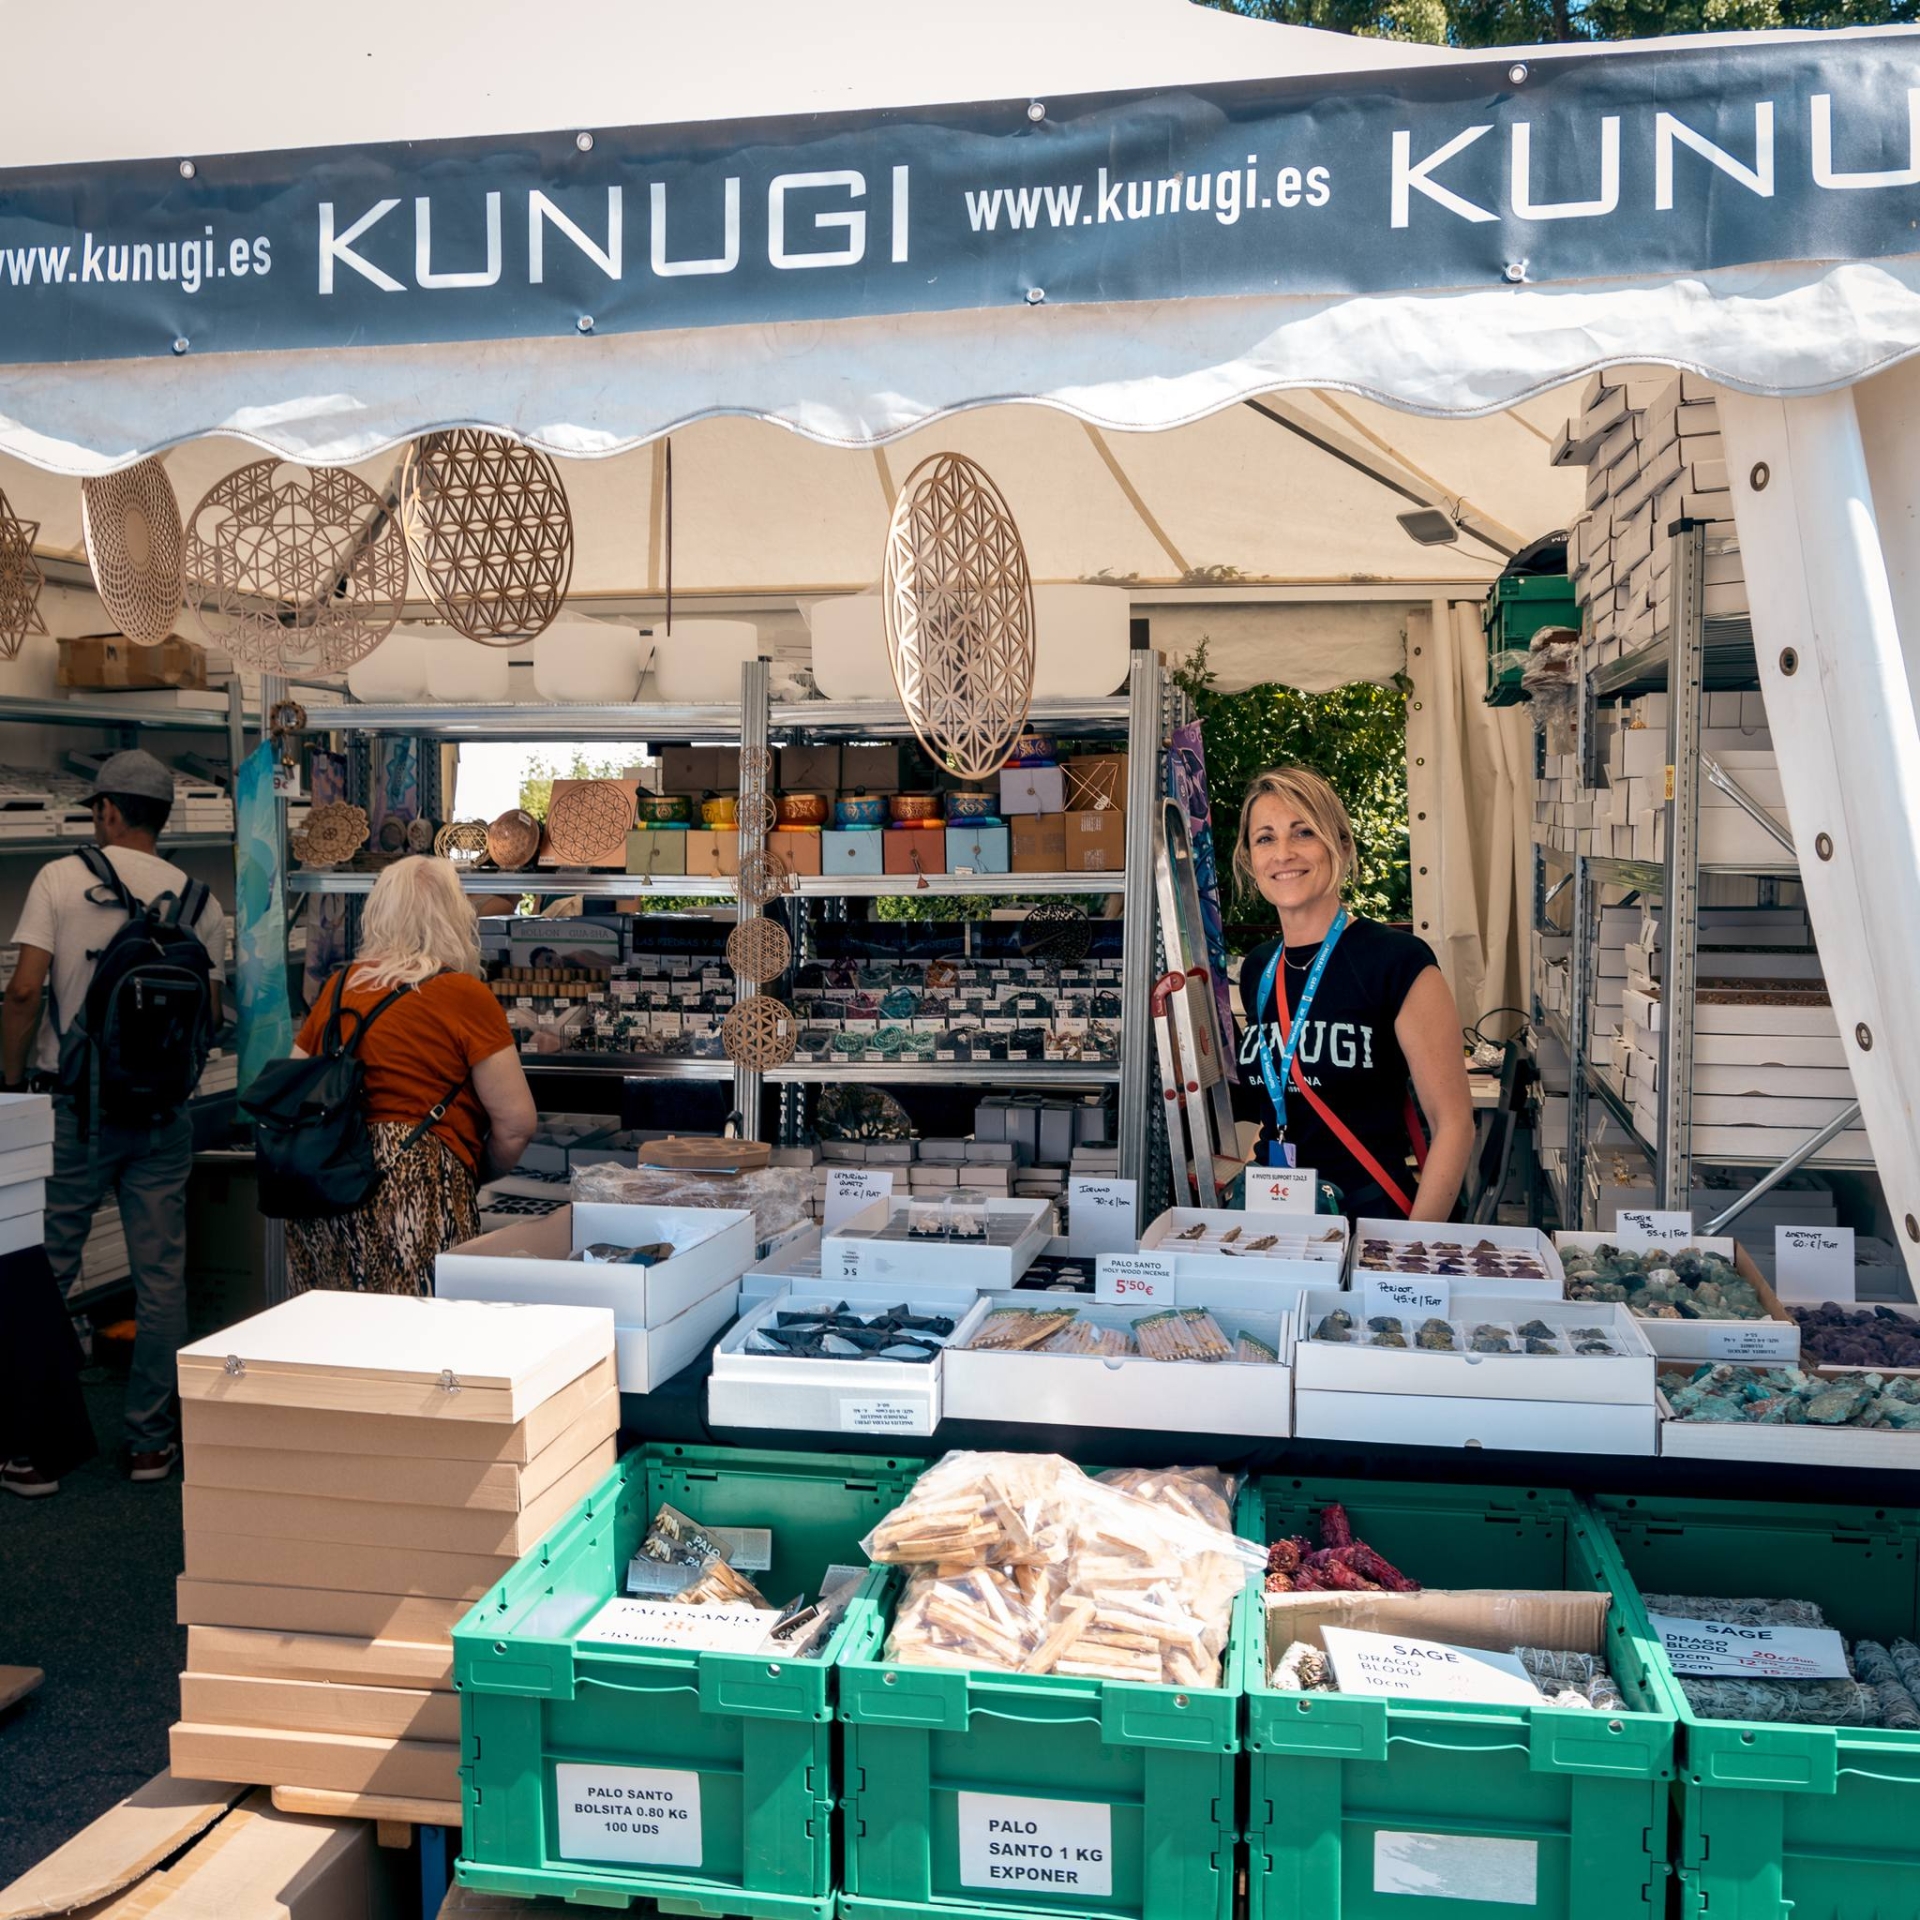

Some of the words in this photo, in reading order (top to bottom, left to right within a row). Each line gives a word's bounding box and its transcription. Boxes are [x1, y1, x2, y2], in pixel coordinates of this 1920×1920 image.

[1390, 88, 1920, 229] KUNU
[964, 154, 1331, 232] www.kunugi.es
[318, 165, 911, 296] KUNUGI
[0, 226, 271, 293] ww.kunugi.es
[1111, 1260, 1132, 1268] PALO
[1134, 1261, 1162, 1270] SANTO
[1142, 1270, 1171, 1278] INCENSE
[1665, 1633, 1729, 1647] DRAGO
[1705, 1625, 1773, 1640] SAGE
[1392, 1644, 1460, 1664] SAGE
[1666, 1641, 1728, 1654] BLOOD
[1357, 1652, 1420, 1668] DRAGO
[1360, 1661, 1422, 1677] BLOOD
[587, 1787, 623, 1799] PALO
[627, 1789, 674, 1802] SANTO
[574, 1803, 633, 1816] BOLSITA
[636, 1806, 665, 1819] 0.80
[668, 1809, 688, 1820] KG
[605, 1821, 628, 1833] 100
[632, 1823, 660, 1835] UDS
[989, 1819, 1038, 1835] PALO
[989, 1842, 1053, 1859] SANTO
[1060, 1847, 1068, 1860] 1
[1076, 1848, 1104, 1862] KG
[990, 1865, 1079, 1884] EXPONER
